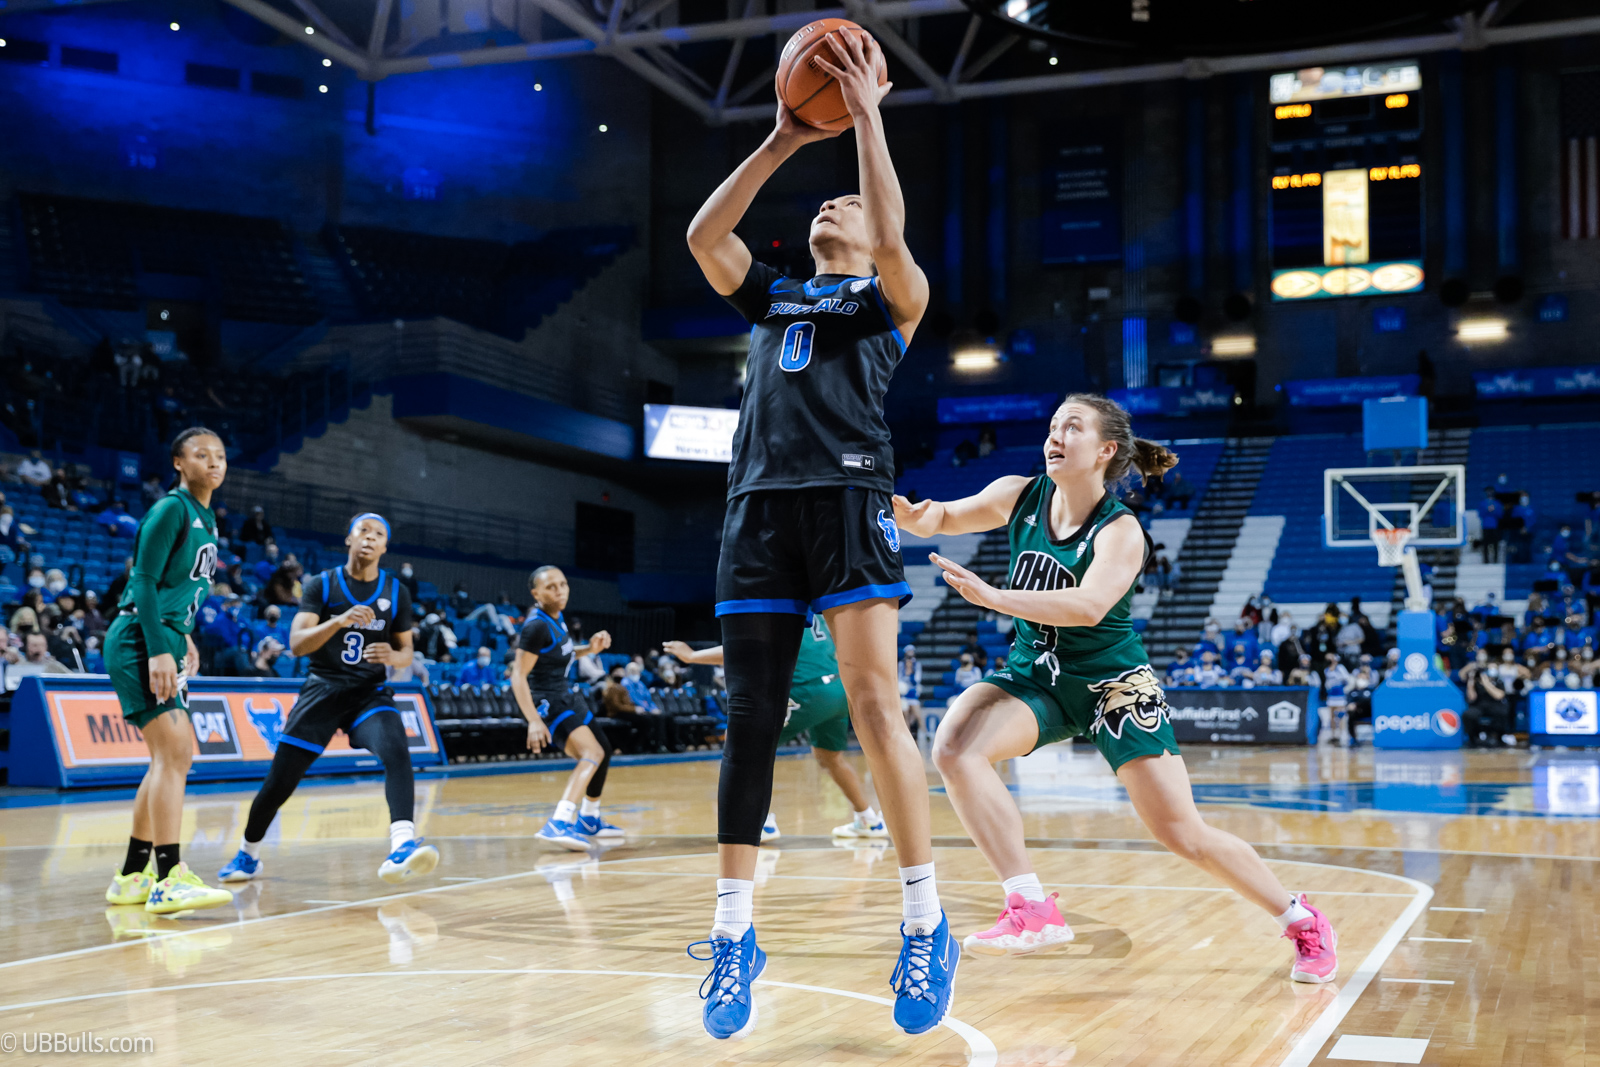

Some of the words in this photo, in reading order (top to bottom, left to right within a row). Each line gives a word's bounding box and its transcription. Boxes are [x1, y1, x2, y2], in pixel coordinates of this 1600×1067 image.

[778, 320, 816, 373] 0
[864, 459, 871, 467] M
[341, 631, 365, 665] 3
[191, 711, 230, 743] CAT
[1374, 712, 1431, 734] pepsi
